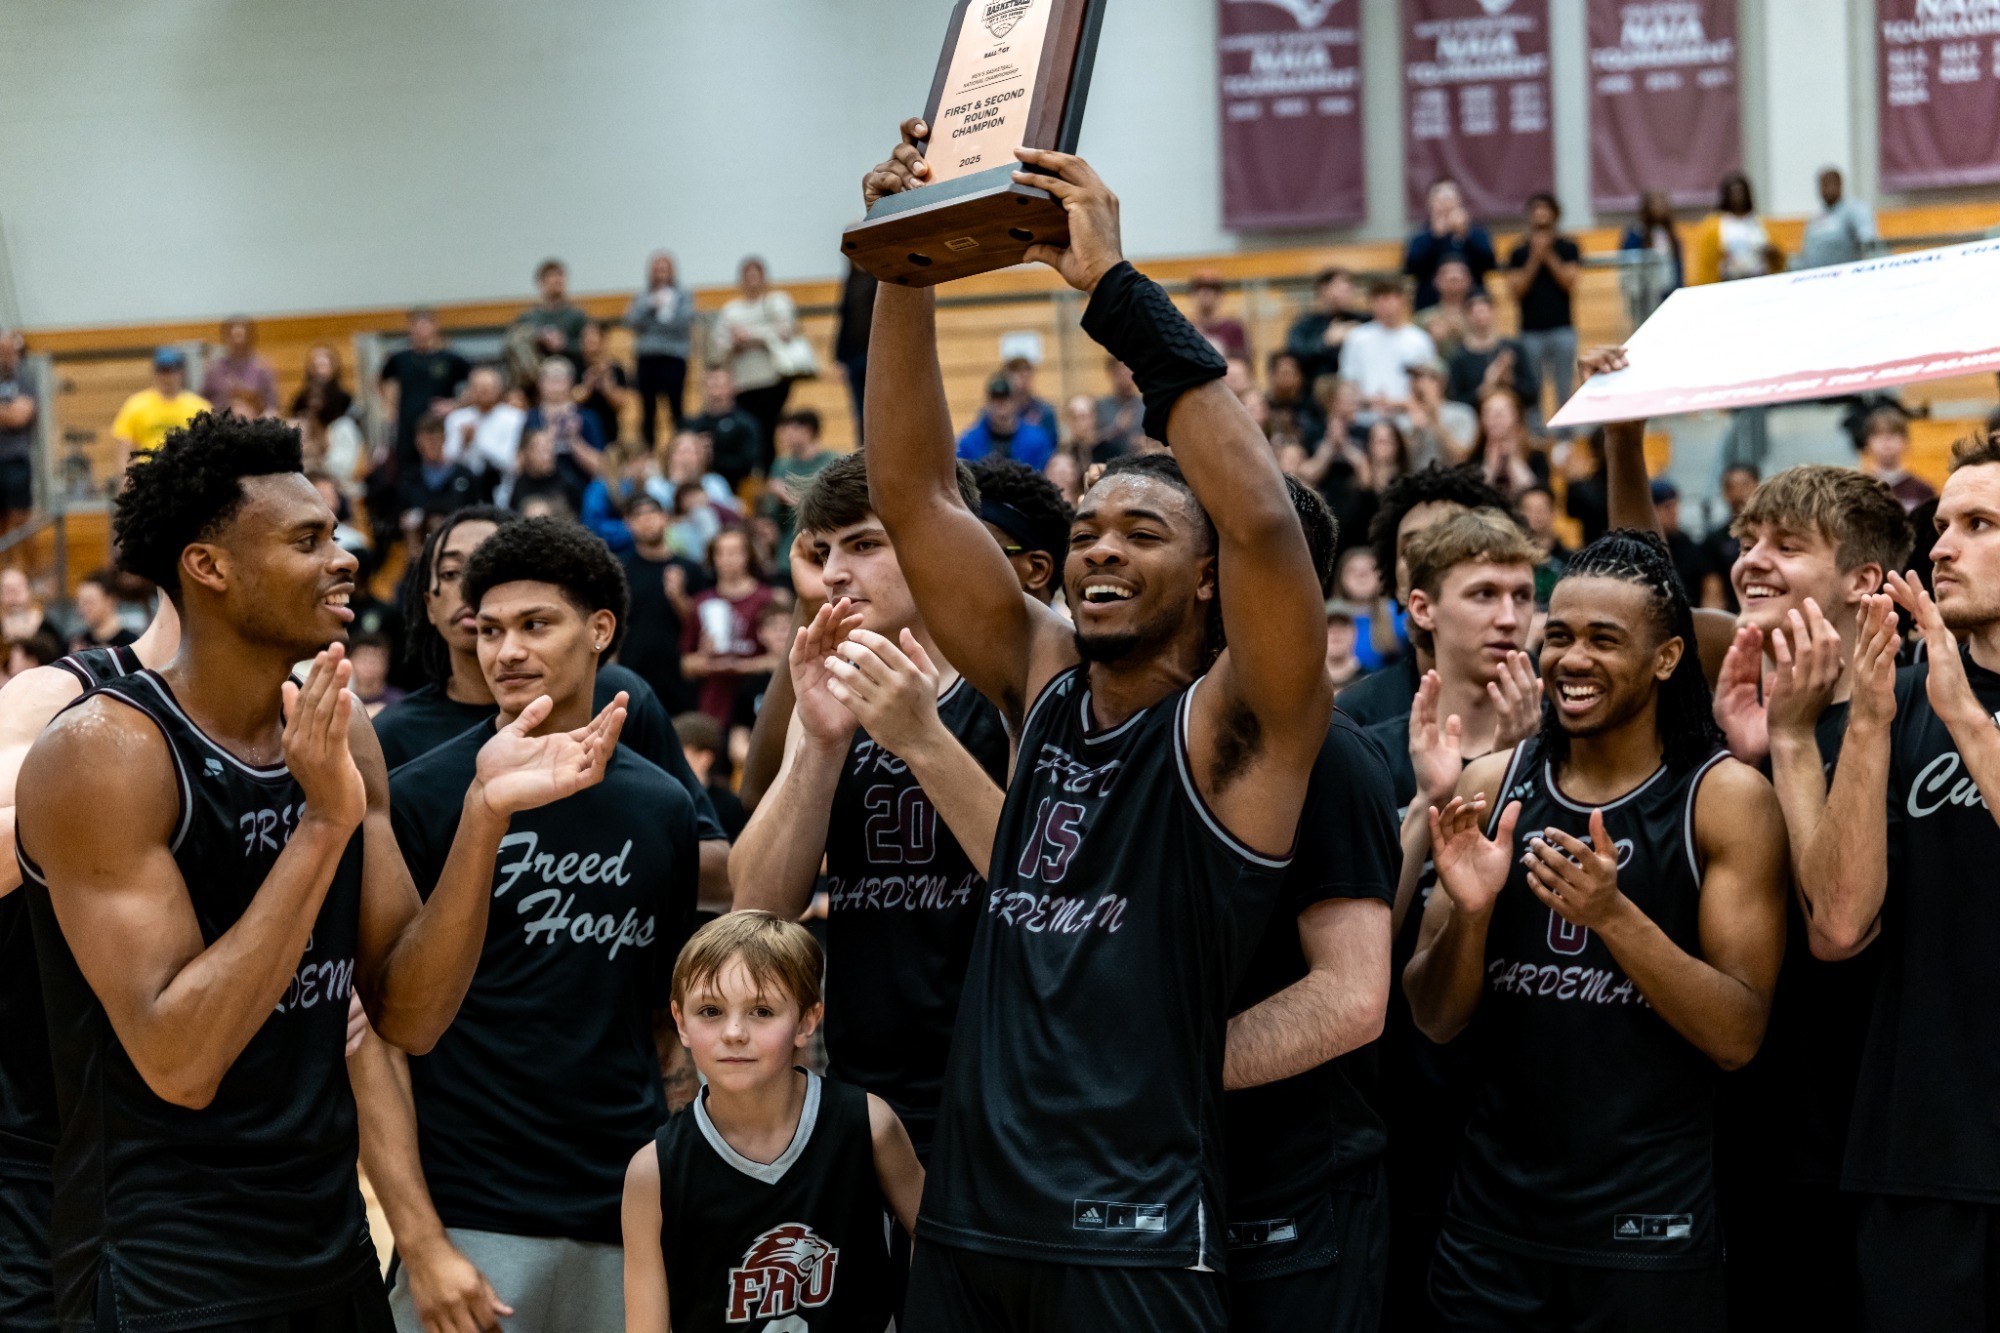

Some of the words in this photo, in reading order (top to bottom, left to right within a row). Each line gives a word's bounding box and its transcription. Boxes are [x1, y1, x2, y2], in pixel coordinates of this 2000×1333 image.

[944, 102, 973, 118] FIRST
[974, 99, 982, 110] &
[984, 88, 1025, 107] SECOND
[952, 116, 1005, 139] CHAMPION
[964, 107, 999, 124] ROUND
[959, 155, 981, 167] 2025
[1907, 752, 1990, 818] Cu
[864, 784, 936, 864] 20
[1018, 797, 1085, 883] 15
[494, 831, 633, 898] Freed
[828, 873, 980, 912] HARDEMA
[517, 888, 655, 961] Hoops
[1488, 958, 1651, 1007] HARDEMA
[1119, 1216, 1124, 1225] L
[726, 1248, 839, 1323] FHU
